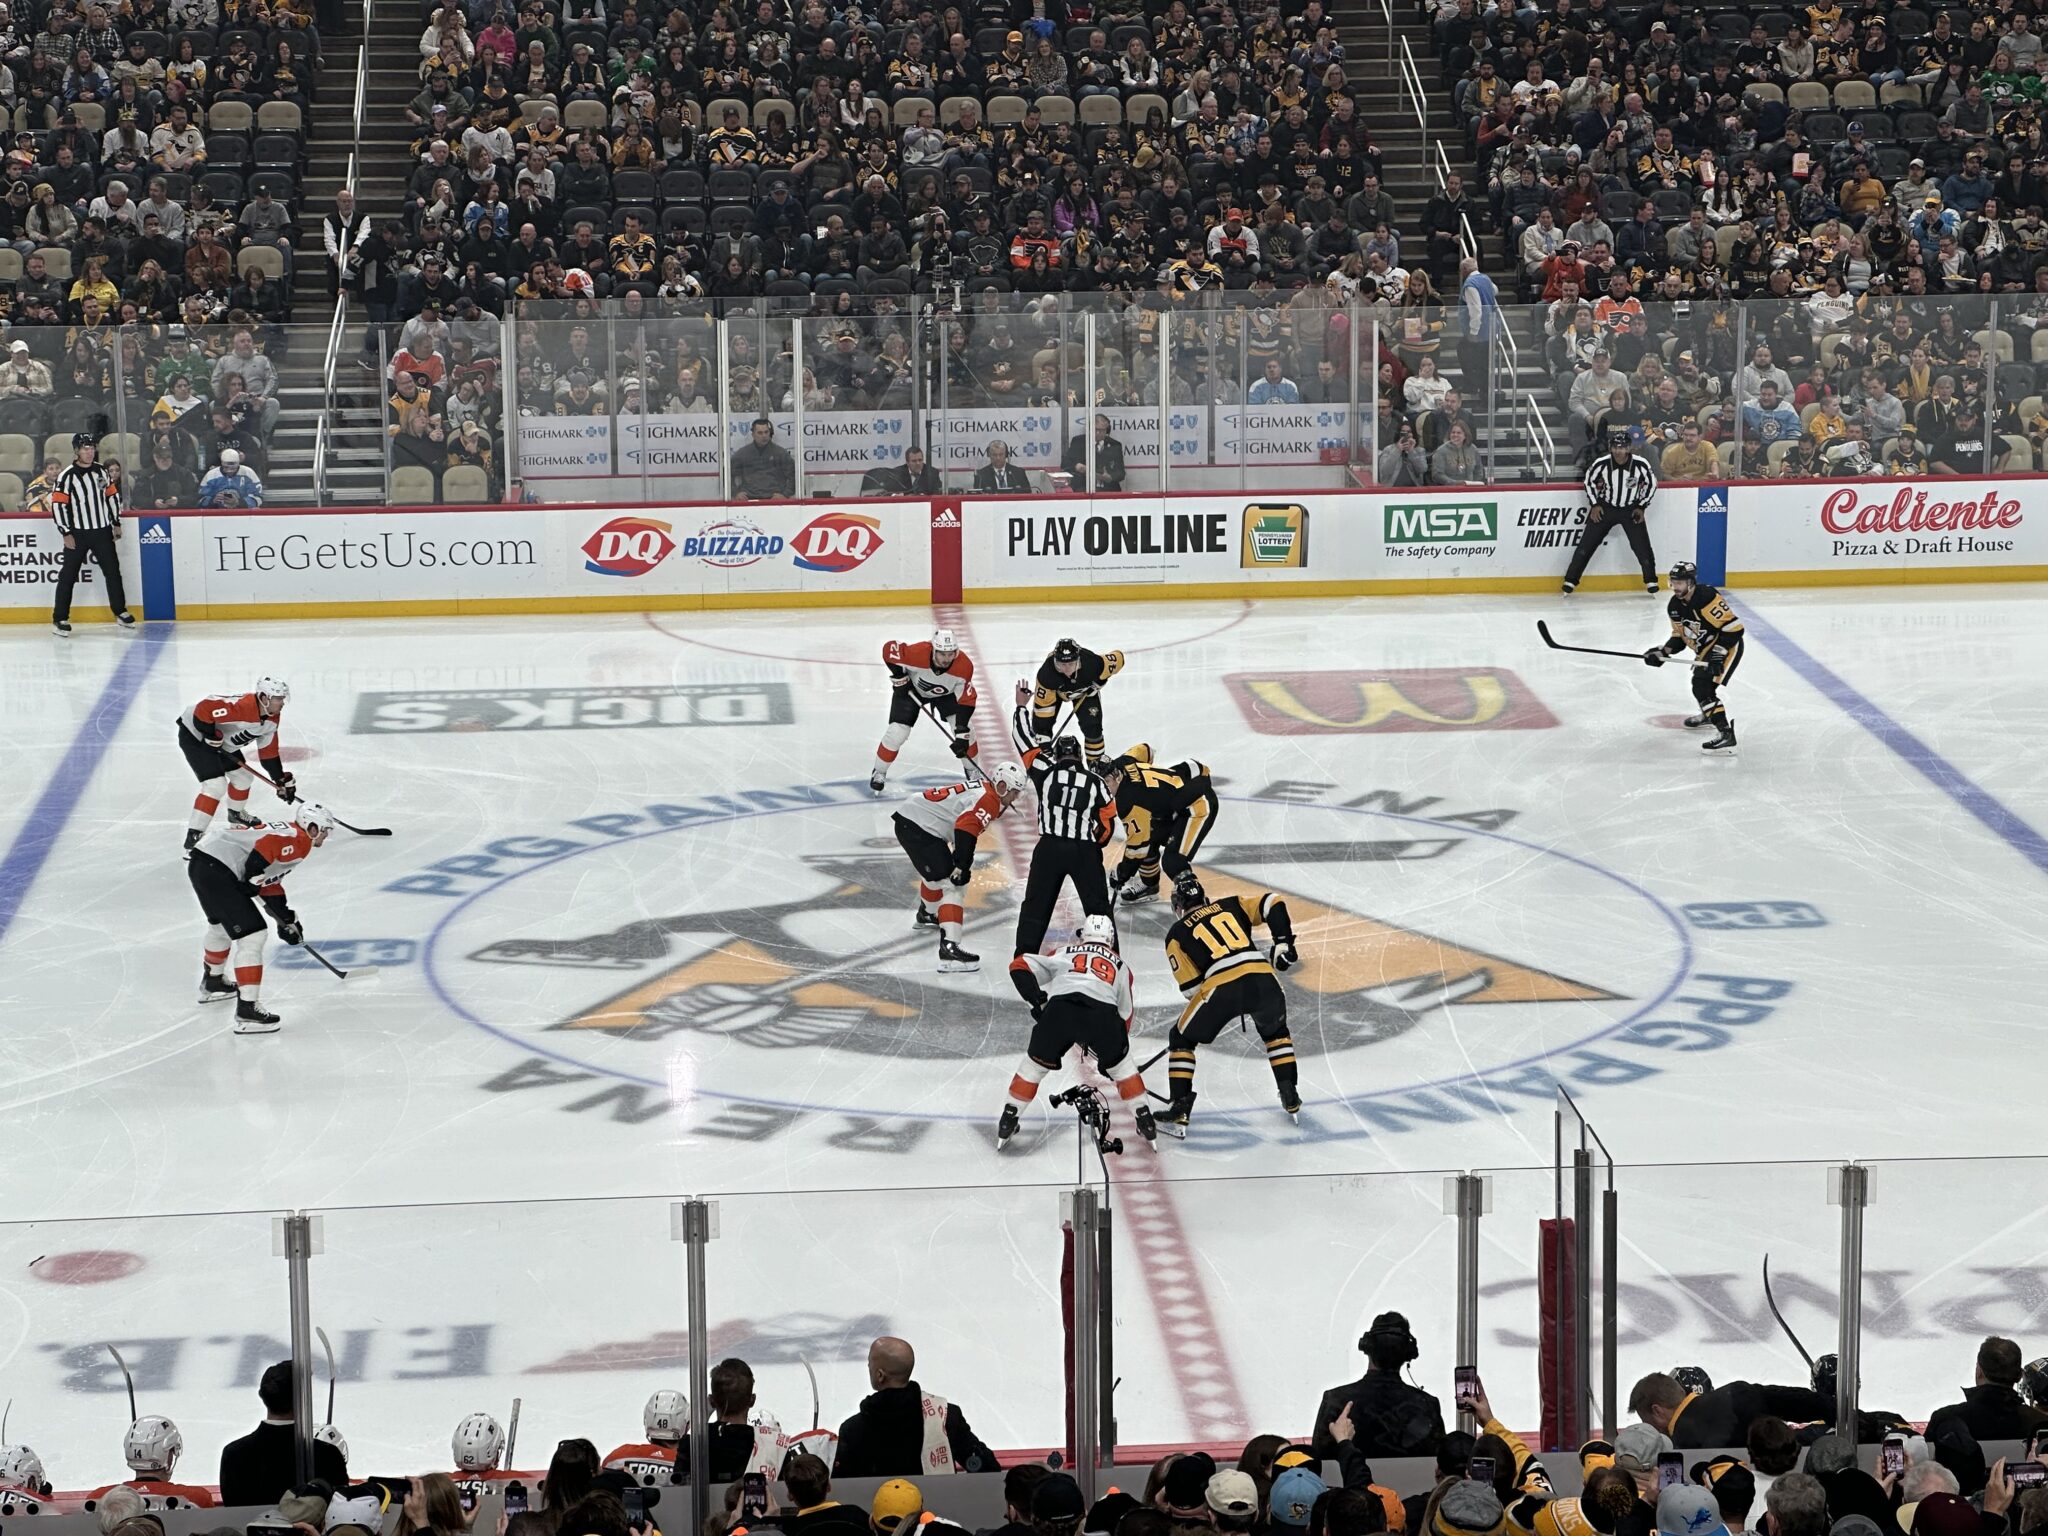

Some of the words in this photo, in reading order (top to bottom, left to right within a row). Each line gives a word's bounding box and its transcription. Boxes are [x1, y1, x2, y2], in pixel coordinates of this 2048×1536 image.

[521, 429, 583, 439] HIGHMARK
[787, 420, 868, 436] GHMARK
[522, 454, 584, 466] HIGHMARK
[937, 445, 1018, 460] IGHMK
[1517, 507, 1573, 527] EVERY
[1698, 505, 1728, 513] adidas
[1820, 486, 2023, 535] Caliente
[931, 520, 962, 528] adidas
[1389, 507, 1493, 538] MSA
[140, 536, 172, 544] adidas
[804, 526, 871, 561] DQ
[1008, 516, 1077, 557] PLAY
[1083, 513, 1228, 557] ONLINE
[1258, 538, 1293, 546] LOTTERY
[214, 532, 537, 573] HeGetsUs.com
[597, 530, 663, 565] DQ
[683, 535, 784, 557] BLIZZARD
[1385, 546, 1404, 557] The
[1407, 545, 1442, 559] Safety
[1443, 545, 1496, 558] Company
[1832, 541, 1878, 556] Pizza
[1883, 540, 1900, 555] &
[1905, 536, 1952, 555] Draft
[1957, 536, 2014, 553] House
[0, 552, 100, 566] CHANGG
[0, 569, 93, 583] MEDICE
[1709, 601, 1731, 620] 58
[211, 707, 228, 718] 8
[1060, 786, 1077, 807] 11
[975, 807, 992, 827] 25
[380, 836, 586, 898] PPG
[1184, 902, 1224, 928] O'CONNOR
[1192, 911, 1250, 960] 10
[1069, 944, 1123, 967] HATHAWAY
[1068, 953, 1117, 986] 19
[1612, 972, 1792, 1052] PPG
[1691, 1384, 1704, 1394] 20
[657, 1419, 668, 1429] 48
[134, 1449, 142, 1459] 14
[463, 1455, 474, 1465] 62
[627, 1463, 675, 1477] FROS
